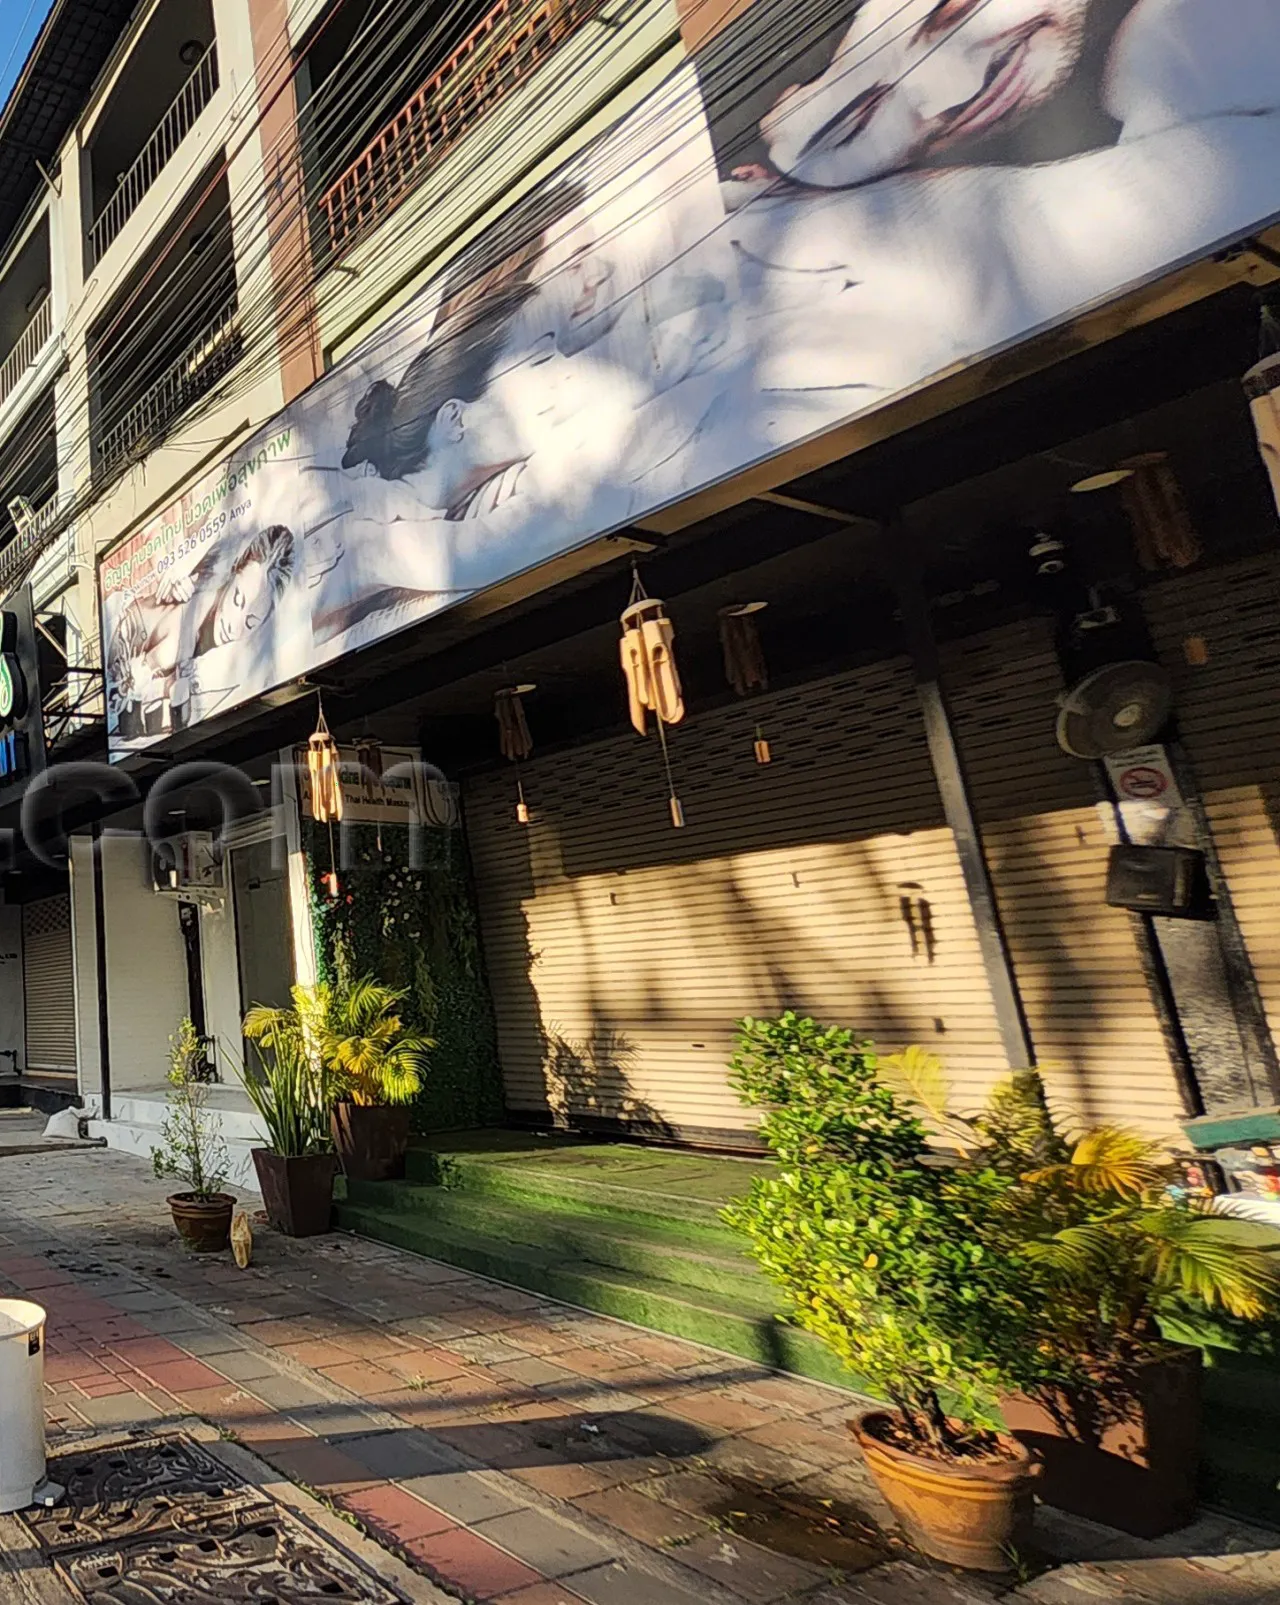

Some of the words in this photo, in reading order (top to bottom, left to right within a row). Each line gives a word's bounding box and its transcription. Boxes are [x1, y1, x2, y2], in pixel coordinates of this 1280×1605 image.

[157, 554, 176, 575] 093
[178, 537, 197, 560] 526
[229, 499, 253, 521] Anya
[345, 794, 361, 804] Thai
[362, 796, 385, 806] Health
